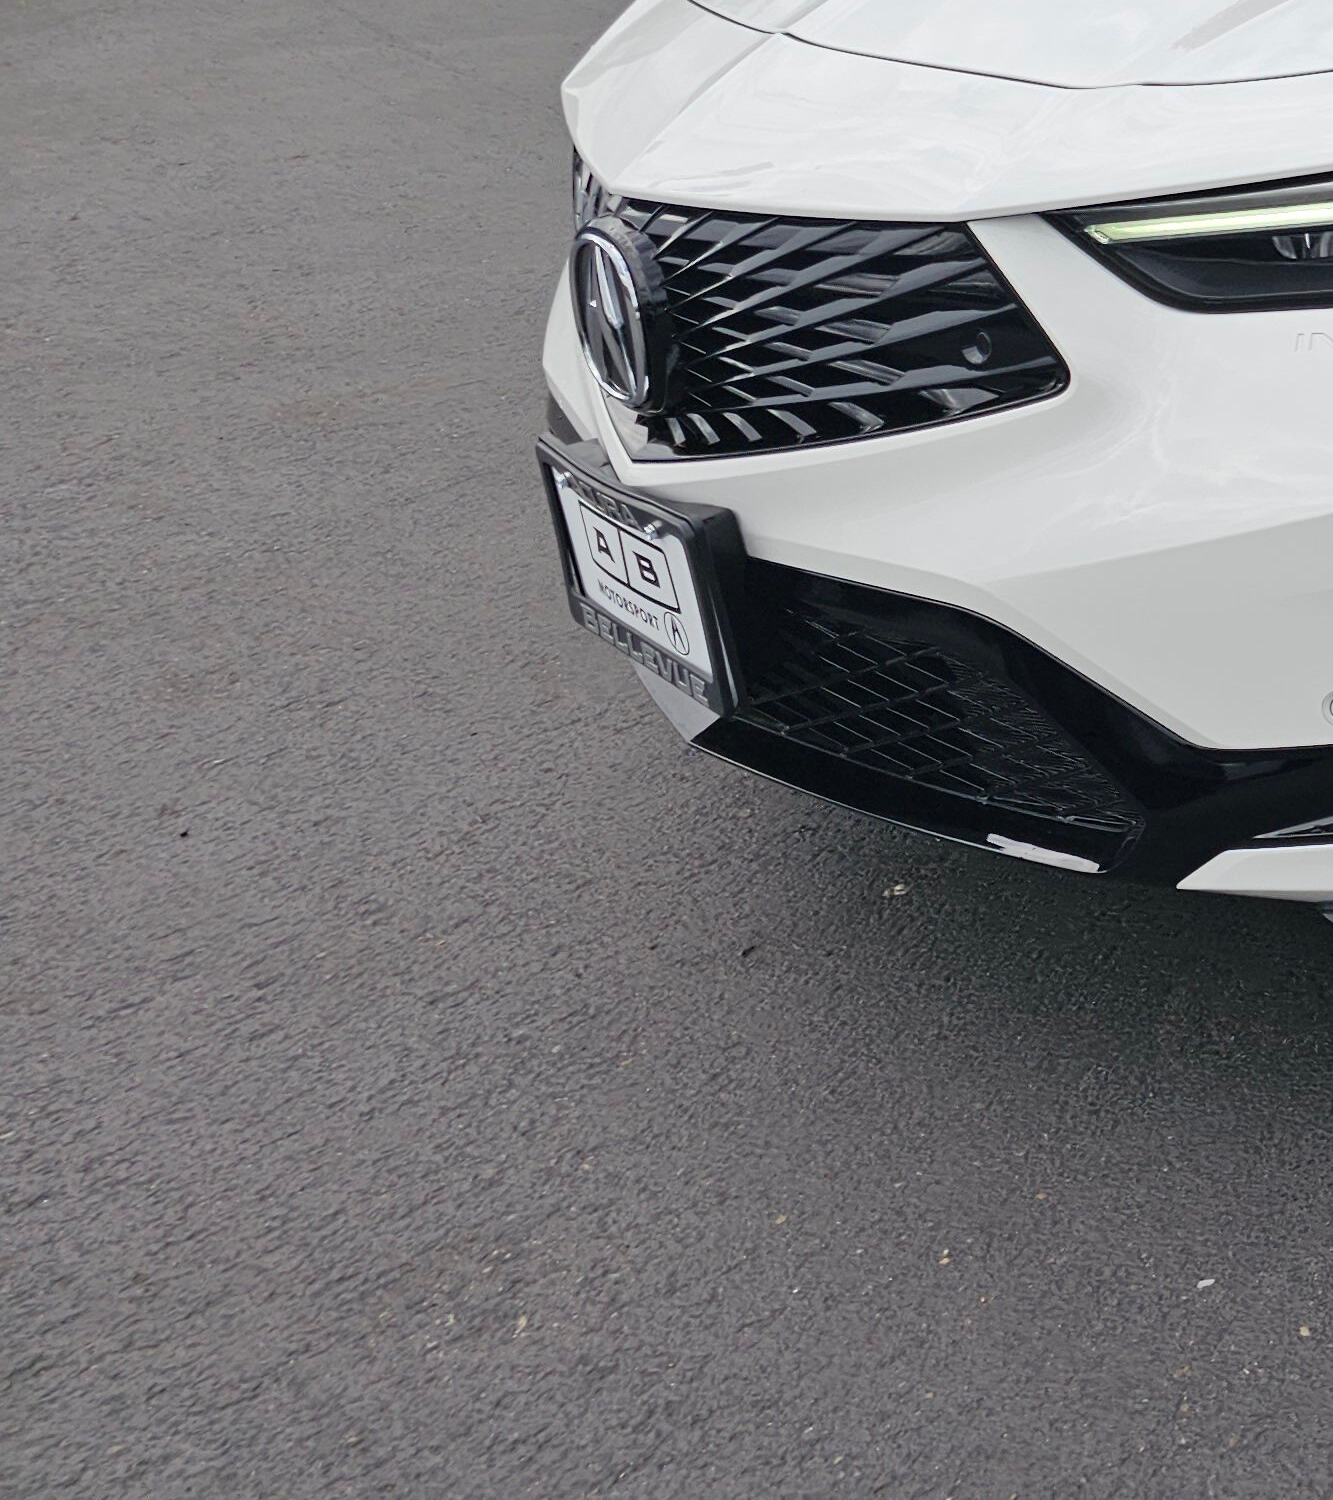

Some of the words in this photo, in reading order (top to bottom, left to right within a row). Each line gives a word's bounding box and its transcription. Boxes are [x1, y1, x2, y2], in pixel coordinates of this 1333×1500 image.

[593, 526, 616, 564] A
[632, 550, 662, 589] B
[597, 578, 660, 632] MOTORSPORT
[580, 601, 710, 709] BELLEVUE
